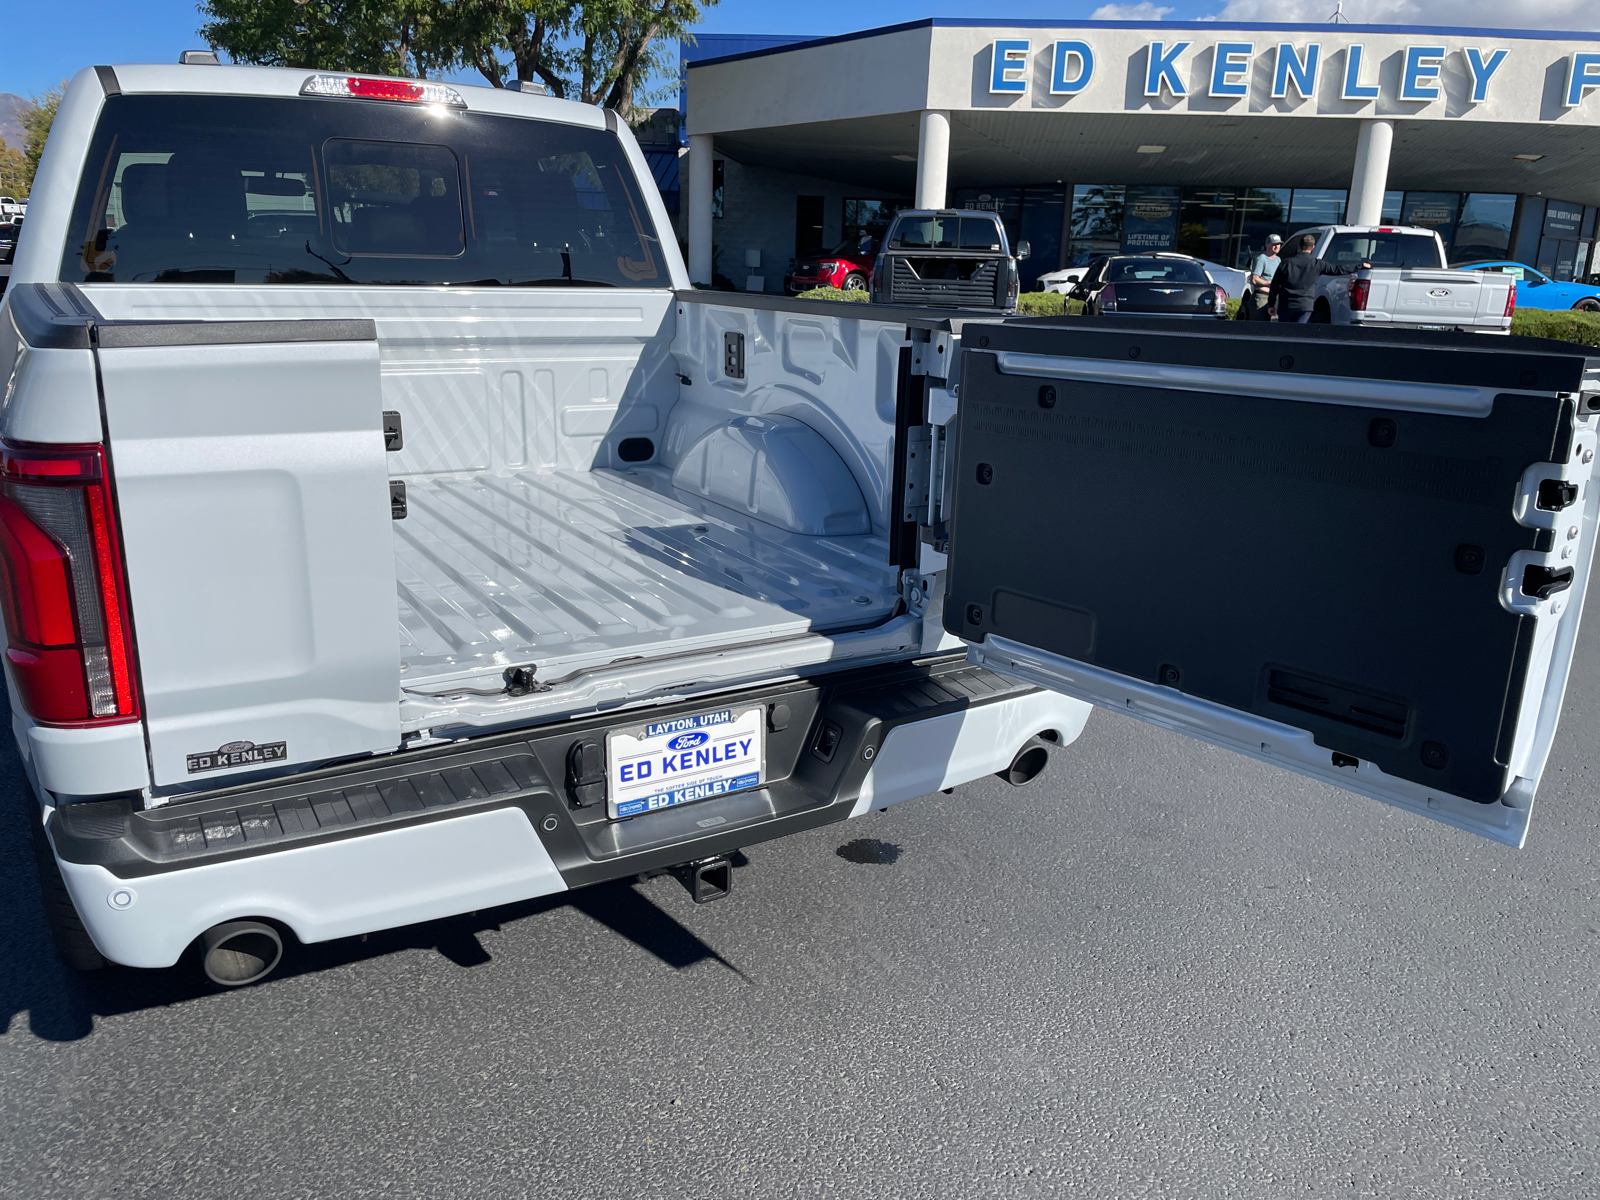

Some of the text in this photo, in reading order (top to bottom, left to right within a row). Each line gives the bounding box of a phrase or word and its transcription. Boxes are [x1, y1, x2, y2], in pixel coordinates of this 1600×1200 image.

[989, 38, 1096, 97] ED
[1144, 40, 1512, 104] KENLEY
[648, 711, 729, 736] LAYTON, UTAH
[675, 734, 702, 750] Ford
[187, 746, 284, 770] ED KENLEY
[620, 738, 753, 783] ED KENLEY
[648, 779, 732, 809] ED KENLEY
[665, 783, 685, 791] SOFTER
[707, 774, 723, 782] TOUCH
